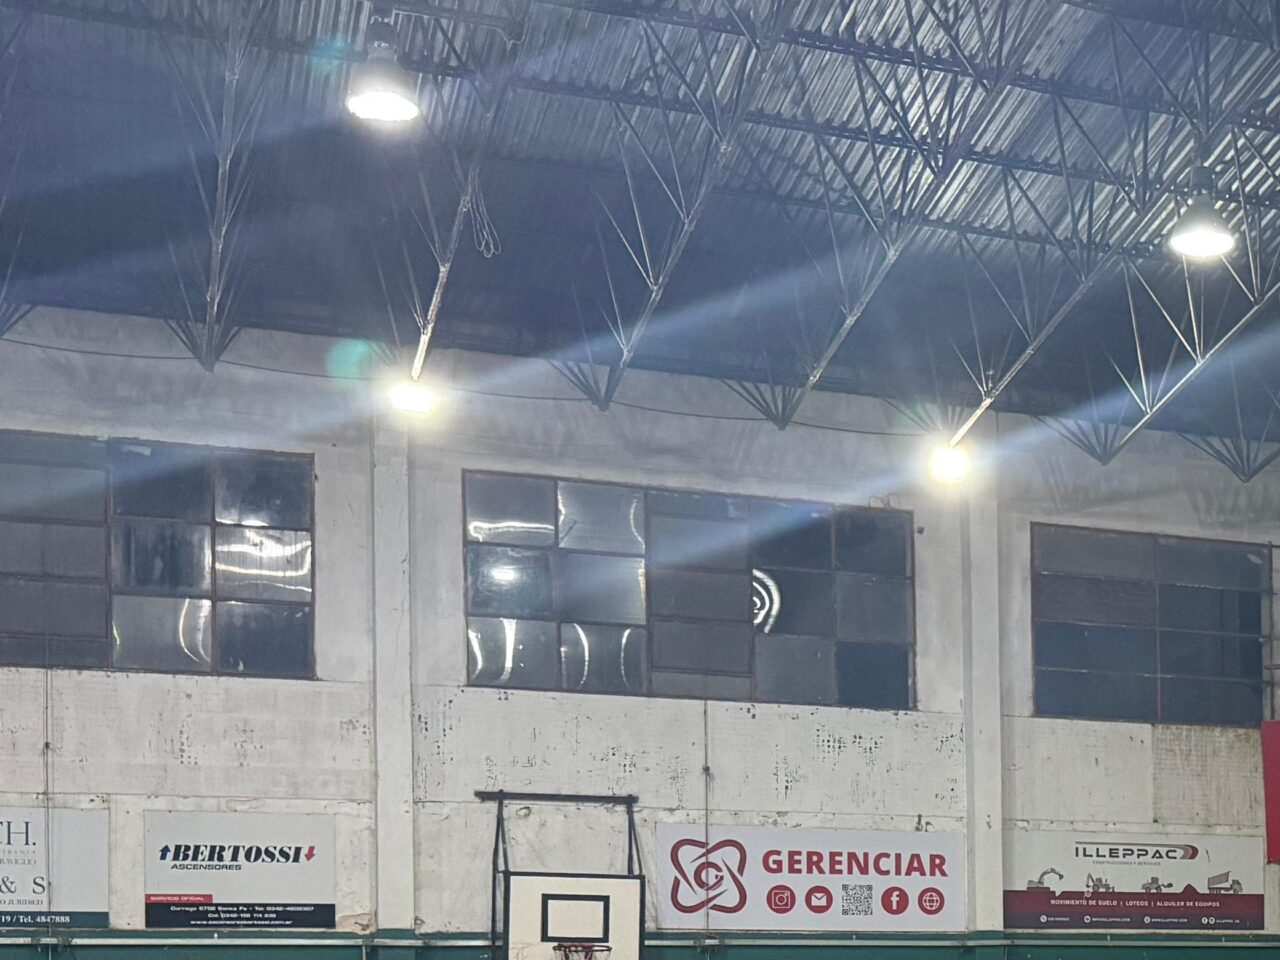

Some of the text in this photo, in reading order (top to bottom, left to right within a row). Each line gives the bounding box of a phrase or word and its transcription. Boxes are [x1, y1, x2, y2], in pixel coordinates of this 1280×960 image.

[0, 821, 36, 846] H.
[171, 844, 304, 864] BERTOSSI
[1075, 846, 1178, 860] ILLEPPAC
[171, 863, 242, 871] ASCENSORES
[762, 849, 949, 878] GERENCIAR
[32, 876, 46, 895] S
[18, 915, 34, 923] Tel.
